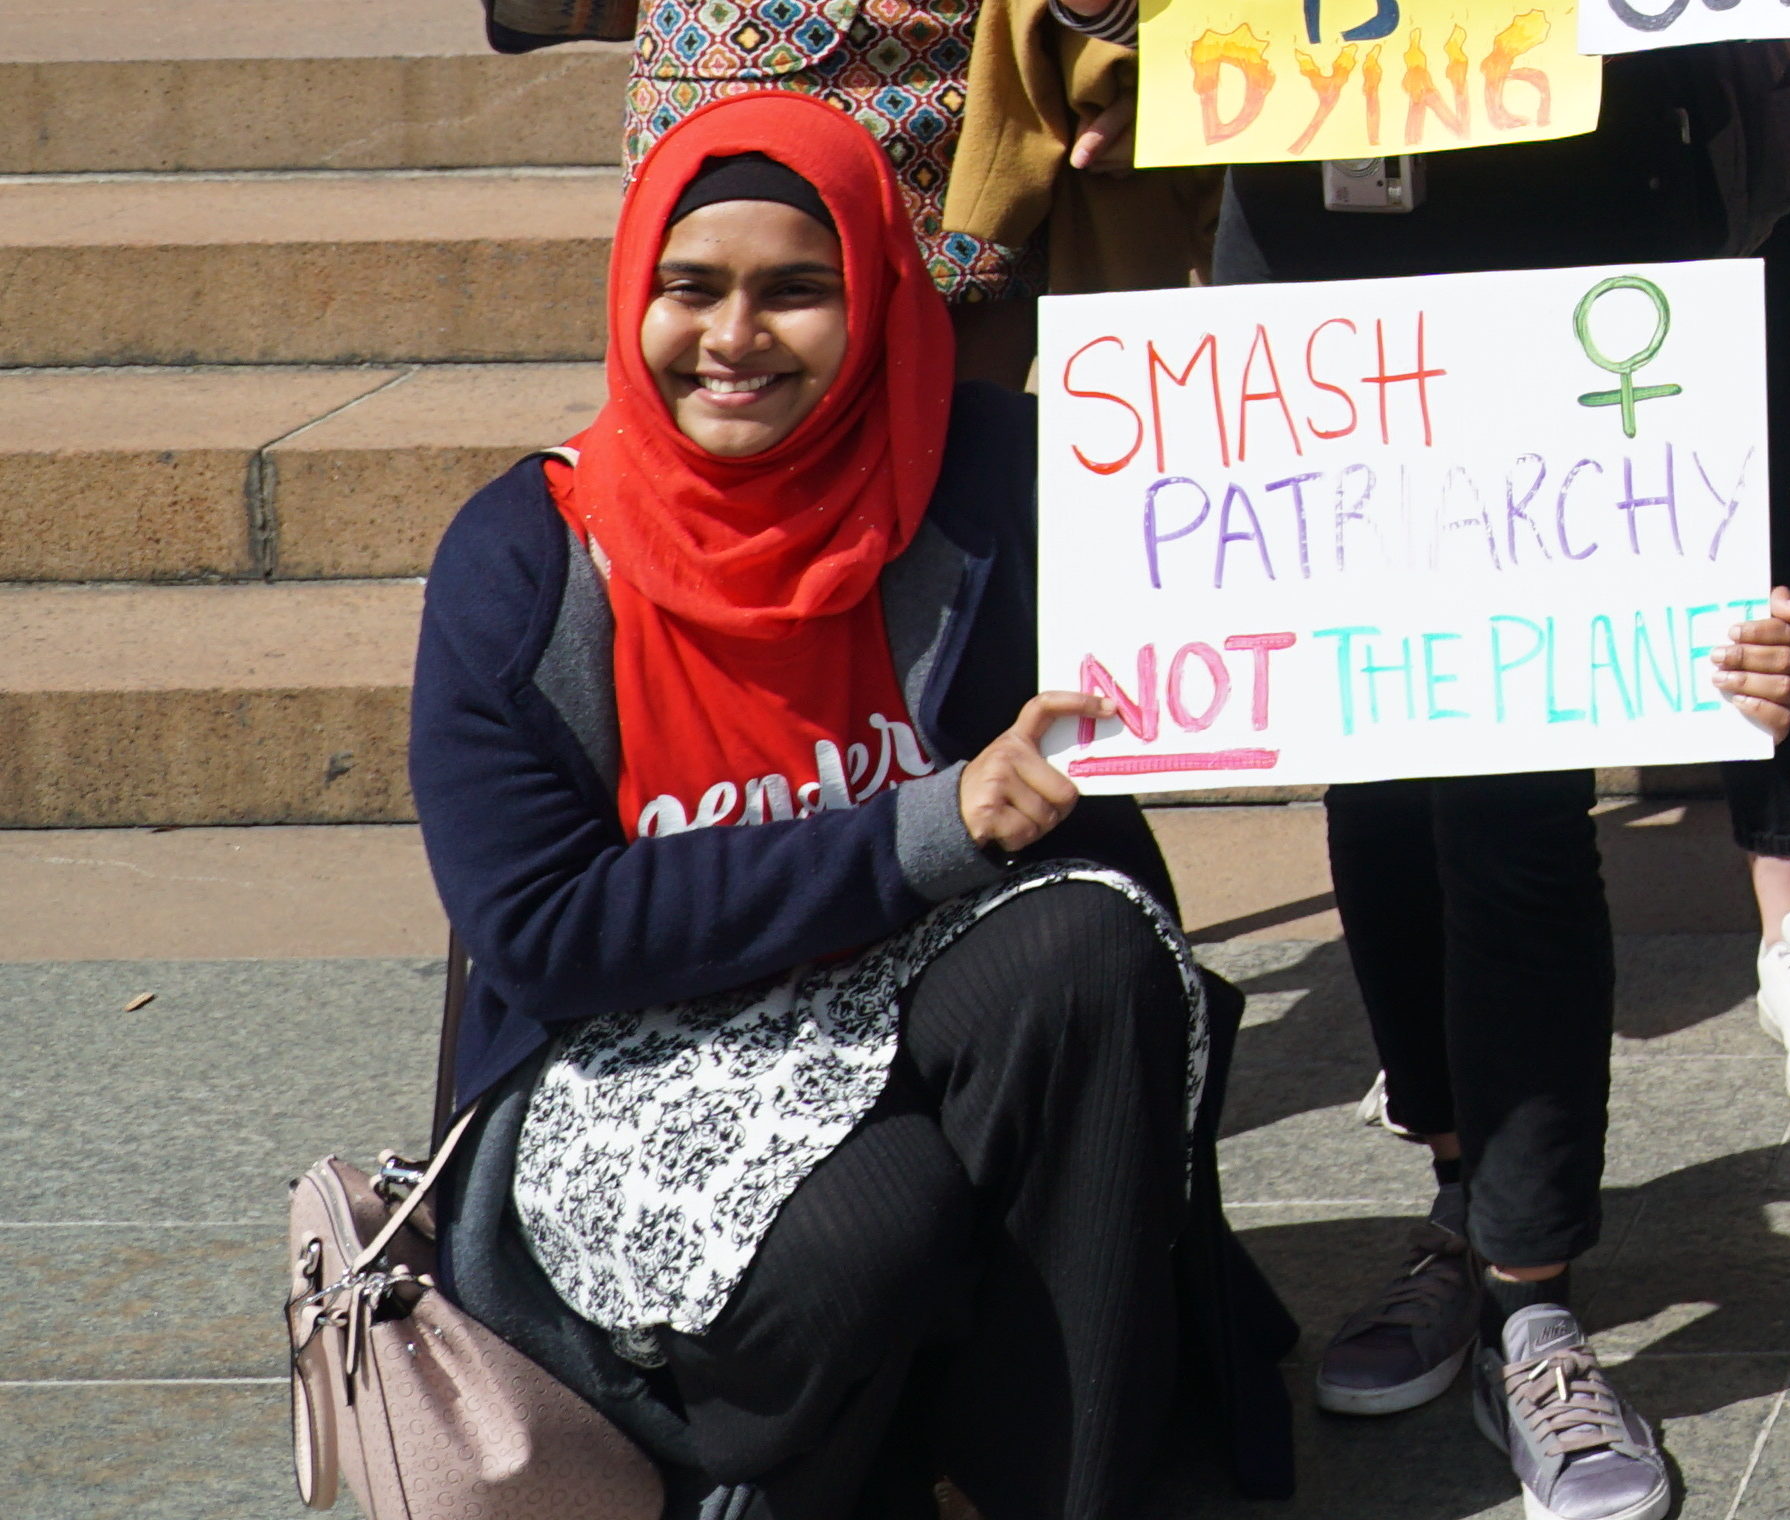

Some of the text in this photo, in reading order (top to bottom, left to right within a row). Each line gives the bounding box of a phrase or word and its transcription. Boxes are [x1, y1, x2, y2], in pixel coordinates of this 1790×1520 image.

[1190, 7, 1553, 156] DYING
[1062, 309, 1447, 476] SMASH
[1144, 441, 1757, 590] PATRIARCHY
[1078, 631, 1297, 750] NOT
[1312, 625, 1472, 737] THE
